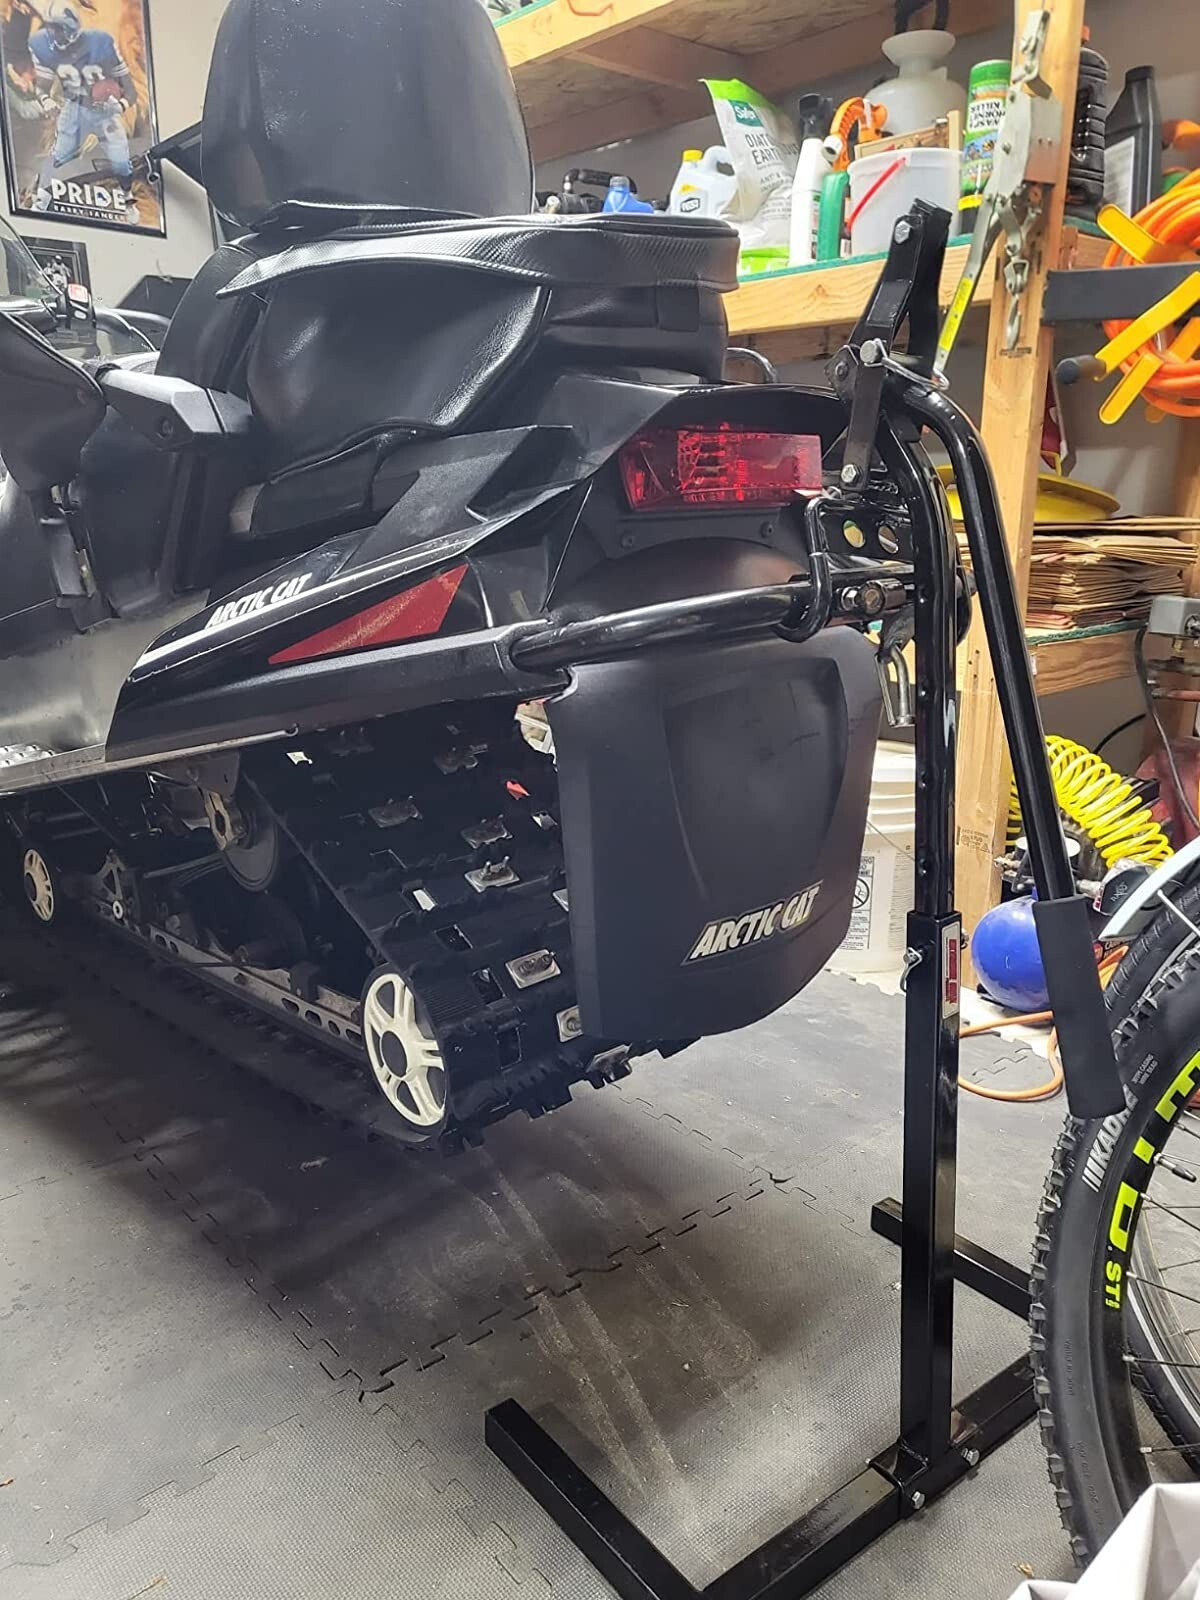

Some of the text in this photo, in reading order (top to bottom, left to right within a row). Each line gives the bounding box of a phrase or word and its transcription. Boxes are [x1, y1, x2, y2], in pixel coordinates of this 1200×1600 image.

[51, 178, 126, 211] PRIDE
[204, 572, 313, 630] ARCTIC CAT
[689, 903, 784, 960] ARCTIC
[781, 886, 820, 929] CAT
